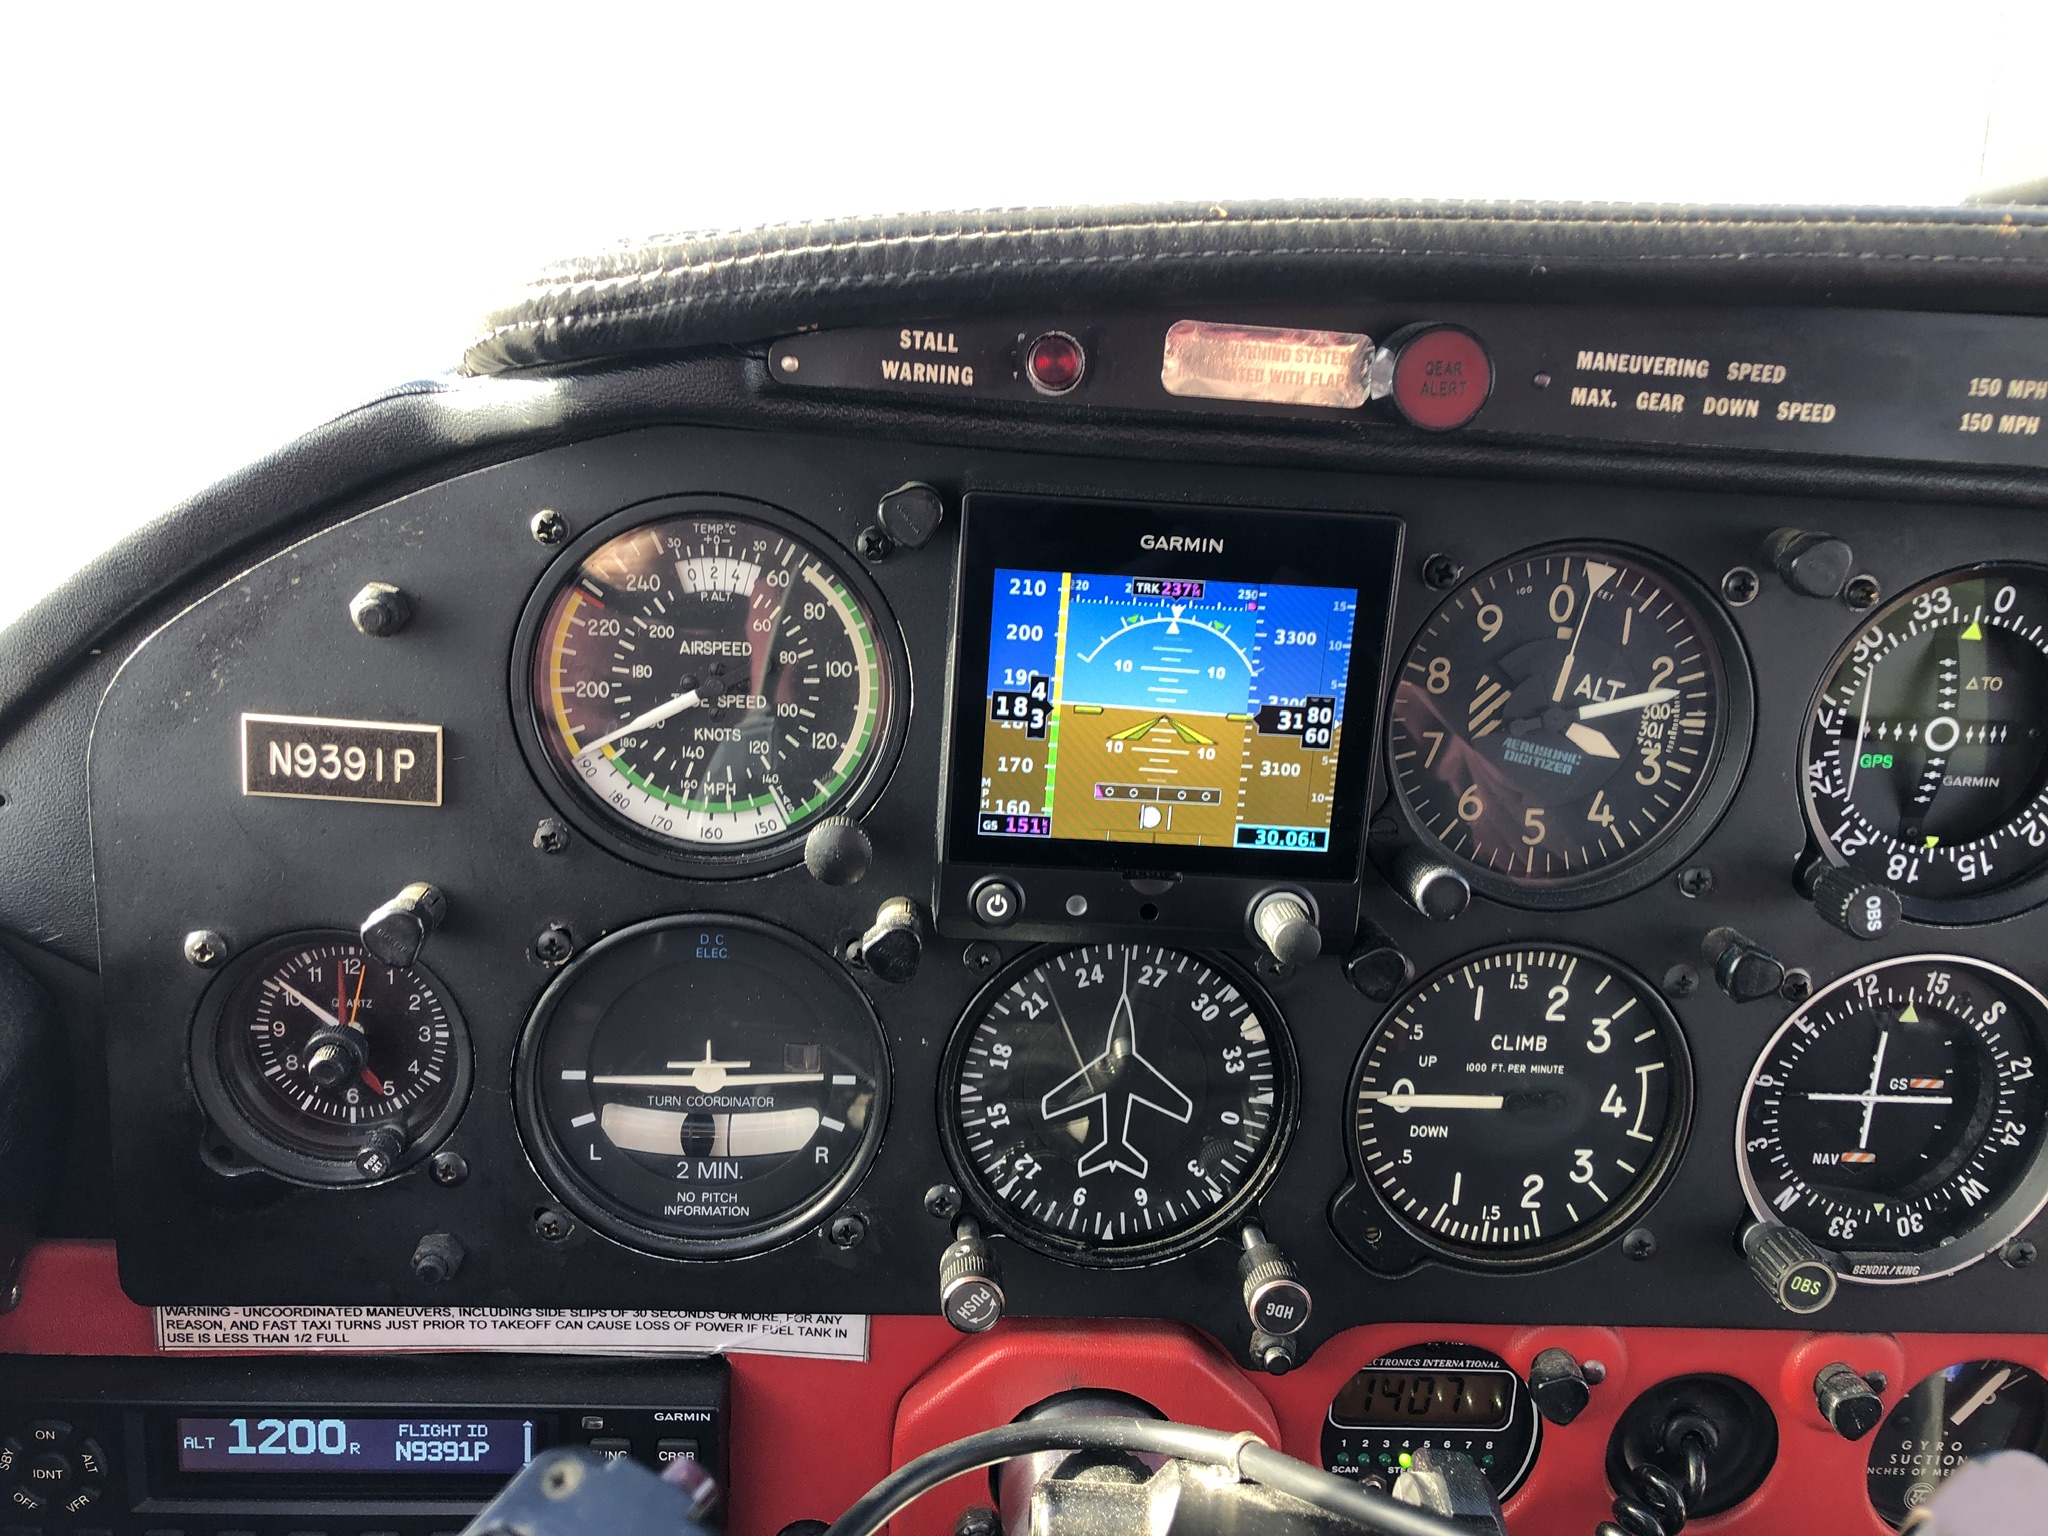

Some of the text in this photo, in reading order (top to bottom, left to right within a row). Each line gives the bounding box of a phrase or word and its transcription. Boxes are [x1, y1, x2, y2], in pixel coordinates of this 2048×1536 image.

[899, 329, 959, 354] STALL
[881, 359, 974, 387] WARNING
[1425, 360, 1463, 377] GEAR
[1576, 350, 1787, 384] MANEUVERING SPEED
[1419, 380, 1467, 397] ALERT
[1968, 376, 2048, 400] 150 MPH
[1570, 386, 1837, 424] MAX. GEAR DOWN SPEED
[1960, 411, 2040, 435] 150 MPH
[1140, 534, 1224, 554] GARMIN
[626, 574, 661, 591] 240
[766, 569, 790, 587] 60
[1009, 578, 1047, 597] 210
[1136, 583, 1160, 594] TRK
[804, 603, 826, 620] 80
[588, 620, 620, 636] 220
[752, 620, 771, 632] 60
[1476, 604, 1503, 643] 9
[649, 626, 675, 638] 200
[1006, 625, 1044, 642] 200
[1274, 630, 1317, 646] 3300
[680, 641, 752, 656] AIRSPEED
[779, 651, 796, 664] 80
[632, 665, 653, 678] 180
[826, 661, 852, 677] 100
[1114, 660, 1133, 673] 10
[1208, 666, 1226, 680] 10
[1427, 656, 1450, 694] 8
[576, 681, 609, 698] 200
[1573, 674, 1626, 703] ALT
[1982, 676, 2003, 691] TO
[718, 696, 767, 709] SPEED
[777, 704, 798, 717] 100
[620, 737, 636, 748] 180
[694, 728, 742, 742] KNOTS
[812, 734, 837, 750] 120
[682, 746, 704, 760] 140
[749, 741, 769, 755] 120
[1105, 741, 1124, 754] 10
[1198, 748, 1216, 760] 10
[1423, 730, 1445, 769] 7
[269, 740, 415, 784] N9391P
[998, 757, 1033, 774] 170
[1260, 761, 1301, 777] 3100
[1860, 754, 1894, 769] GPS
[704, 782, 737, 796] MPH
[1943, 776, 2000, 789] GARMIN
[1458, 784, 1484, 821] 6
[1587, 790, 1615, 827] 4
[700, 827, 723, 840] 160
[755, 820, 778, 835] 150
[982, 817, 1041, 834] GS 151
[1522, 808, 1546, 845] 5
[1866, 895, 1882, 932] OBS
[1075, 963, 1105, 989] 24
[1138, 964, 1170, 989] 27
[1927, 971, 1951, 996] 15
[1853, 973, 1880, 998] 12
[1545, 984, 1570, 1021] 2
[1491, 1034, 1548, 1052] CLIMB
[1586, 1018, 1611, 1054] 3
[1418, 1055, 1438, 1068] UP
[1466, 1063, 1564, 1075] 1000 FT. PER MINUTE
[1889, 1078, 1908, 1091] GS
[647, 1095, 774, 1108] TURN COORDINATOR
[1600, 1084, 1627, 1118] 4
[1410, 1125, 1448, 1138] DOWN
[590, 1145, 602, 1160] L
[815, 1147, 829, 1163] R
[1812, 1152, 1839, 1166] NAV
[363, 1152, 380, 1170] PUSH
[371, 1160, 384, 1175] SET
[1569, 1148, 1594, 1184] 3
[676, 1162, 744, 1179] 2 MIN.
[677, 1192, 738, 1203] NO PITCH
[1520, 1174, 1544, 1209] 2
[664, 1205, 750, 1217] INFORMATION
[1852, 1264, 1920, 1277] BENDIX/KING
[1790, 1275, 1822, 1296] OBS
[165, 1306, 230, 1317] WARNING
[242, 1307, 363, 1317] UNCOORDINATED
[366, 1307, 455, 1319] MANEUVERS,
[458, 1307, 532, 1318] INCLUDING
[535, 1308, 567, 1317] SIDE
[570, 1309, 607, 1318] SLIPS
[611, 1309, 629, 1318] OF
[632, 1309, 648, 1318] 30
[650, 1310, 714, 1319] SECONDS
[718, 1311, 738, 1320] OR
[786, 1313, 812, 1324] FOR
[816, 1315, 842, 1325] ANY
[1266, 1302, 1294, 1319] HDG
[166, 1319, 847, 1338] REASON, AND FAST TAXI TURNS JUST PRIOR TO TAKEOFF CAN CAUSE LOSS OF POWER IF FUEL TANK IN
[167, 1332, 350, 1344] USE IS LESS THAN 1/2 FULL
[1422, 1359, 1500, 1369] INTERNATIONAL
[1363, 1376, 1465, 1415] 1407
[654, 1412, 710, 1422] GARMIN
[35, 1430, 56, 1440] ON
[183, 1418, 361, 1455] ALT 1200 R
[398, 1424, 488, 1437] FLIGHT ID
[395, 1441, 490, 1462] N9391P
[659, 1450, 695, 1461] CRSR
[81, 1453, 99, 1474] ALT
[1332, 1466, 1359, 1474] SCAN
[1912, 1467, 1927, 1476] OF
[32, 1469, 63, 1480] IDNT
[13, 1491, 39, 1511] OFF
[65, 1494, 90, 1514] VFR
